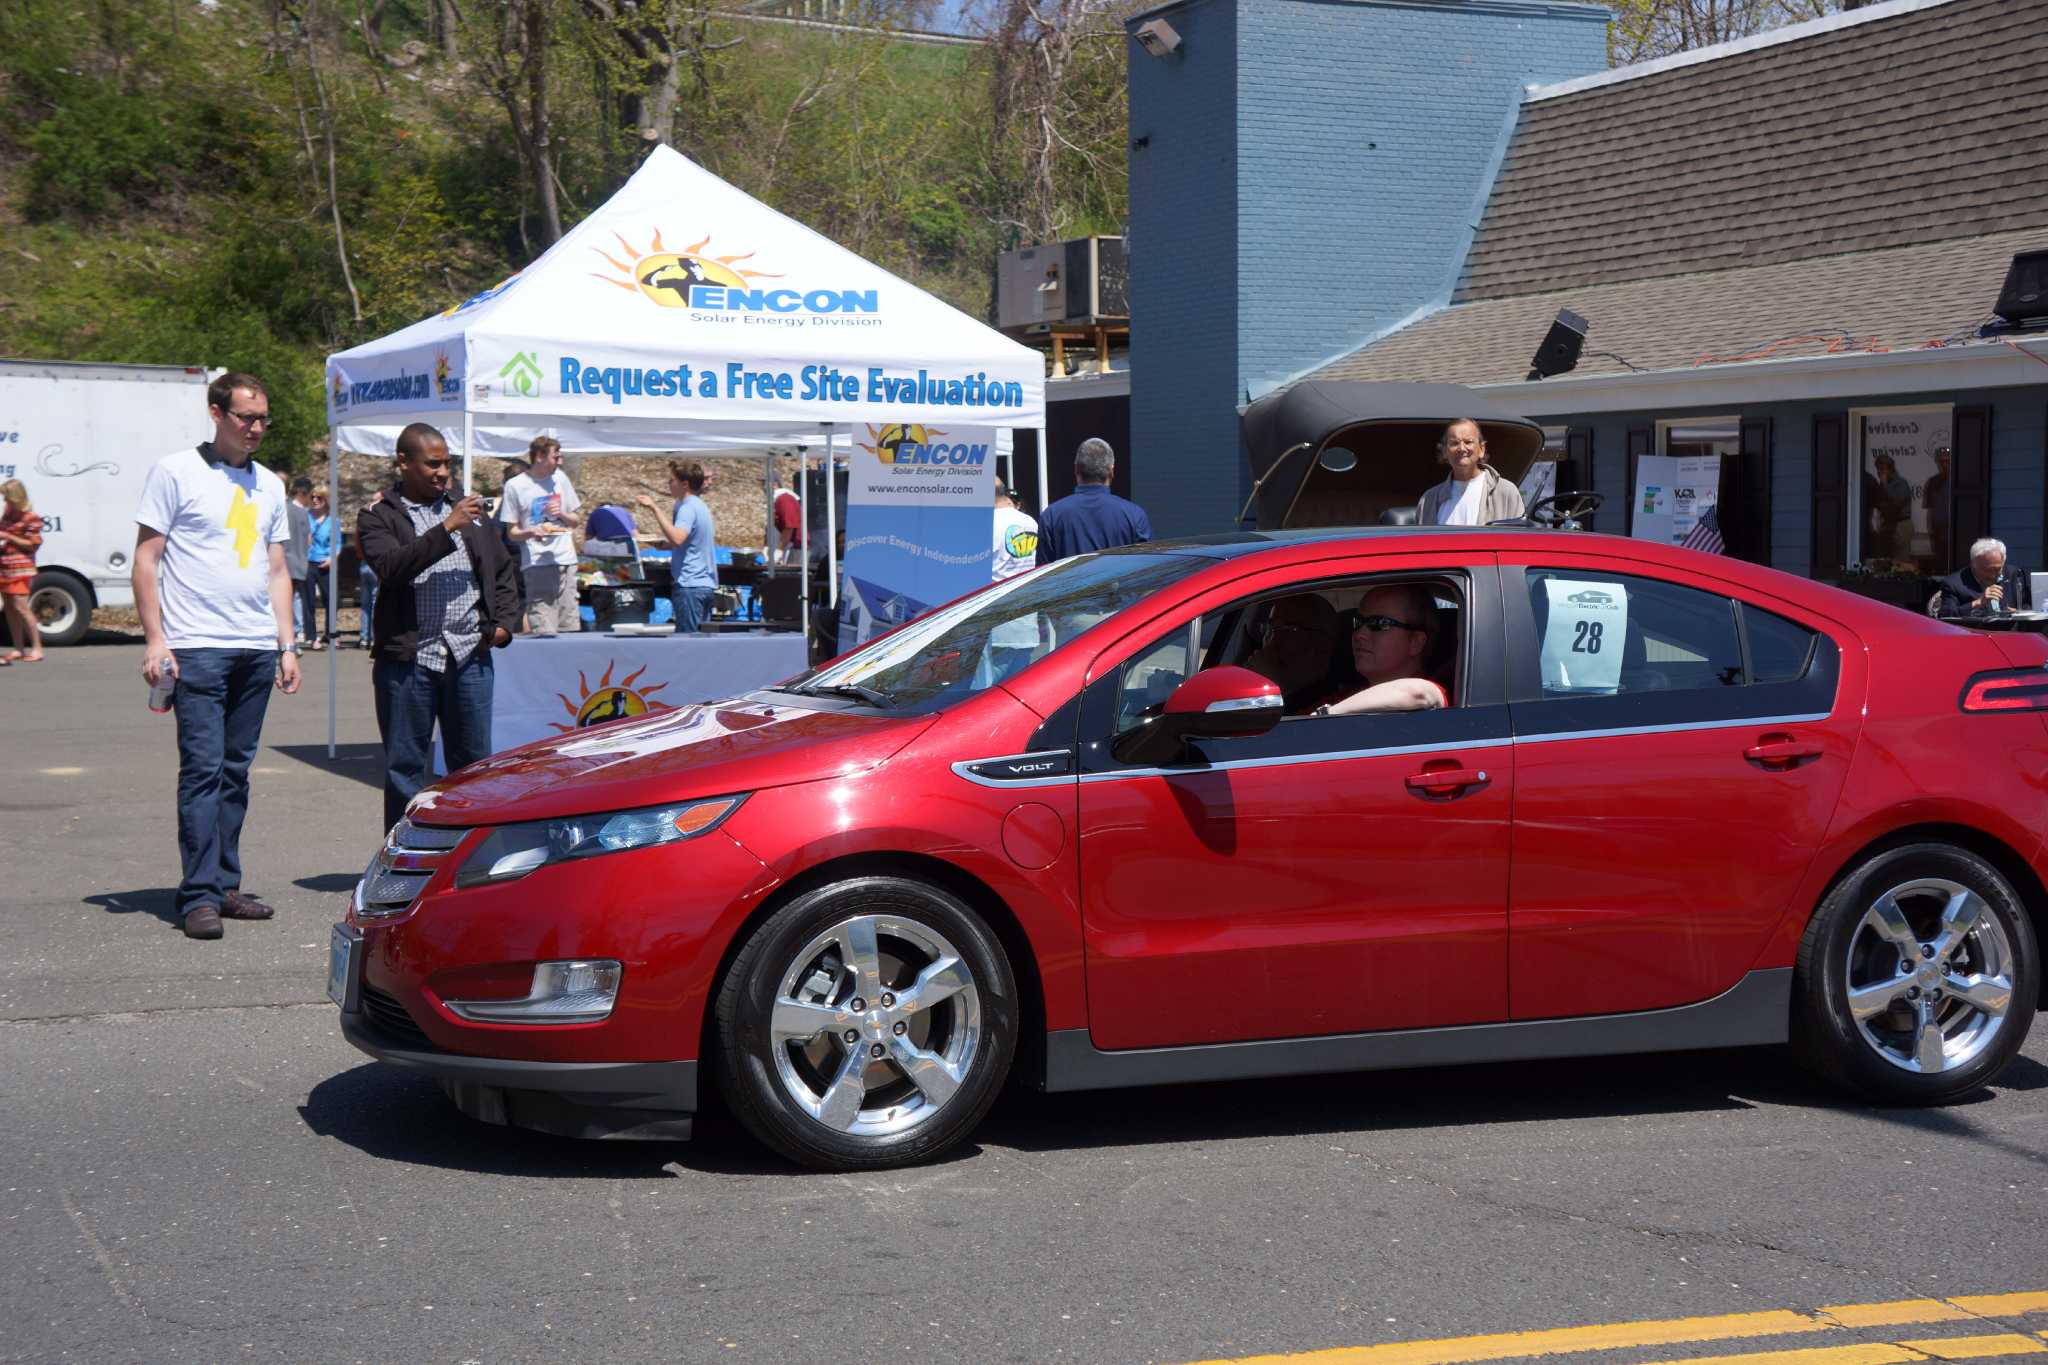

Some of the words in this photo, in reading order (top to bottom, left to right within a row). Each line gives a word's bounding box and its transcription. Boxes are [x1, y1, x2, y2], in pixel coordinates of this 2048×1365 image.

[691, 286, 878, 313] ENCON
[690, 312, 737, 323] Solar
[743, 314, 805, 327] Energy
[812, 316, 882, 326] Division
[559, 356, 692, 405] Request
[699, 370, 718, 399] a
[726, 362, 793, 400] Free
[799, 364, 860, 402] Site
[867, 367, 1023, 408] Evaluation
[895, 442, 988, 465] ENCON
[892, 467, 914, 475] Solar
[916, 467, 945, 477] Energy
[947, 467, 982, 476] Division
[867, 484, 974, 494] www.enconsolar.com
[847, 535, 888, 551] Discover
[889, 535, 922, 556] Energy
[1571, 620, 1604, 655] 28
[1008, 762, 1054, 773] VOLT
